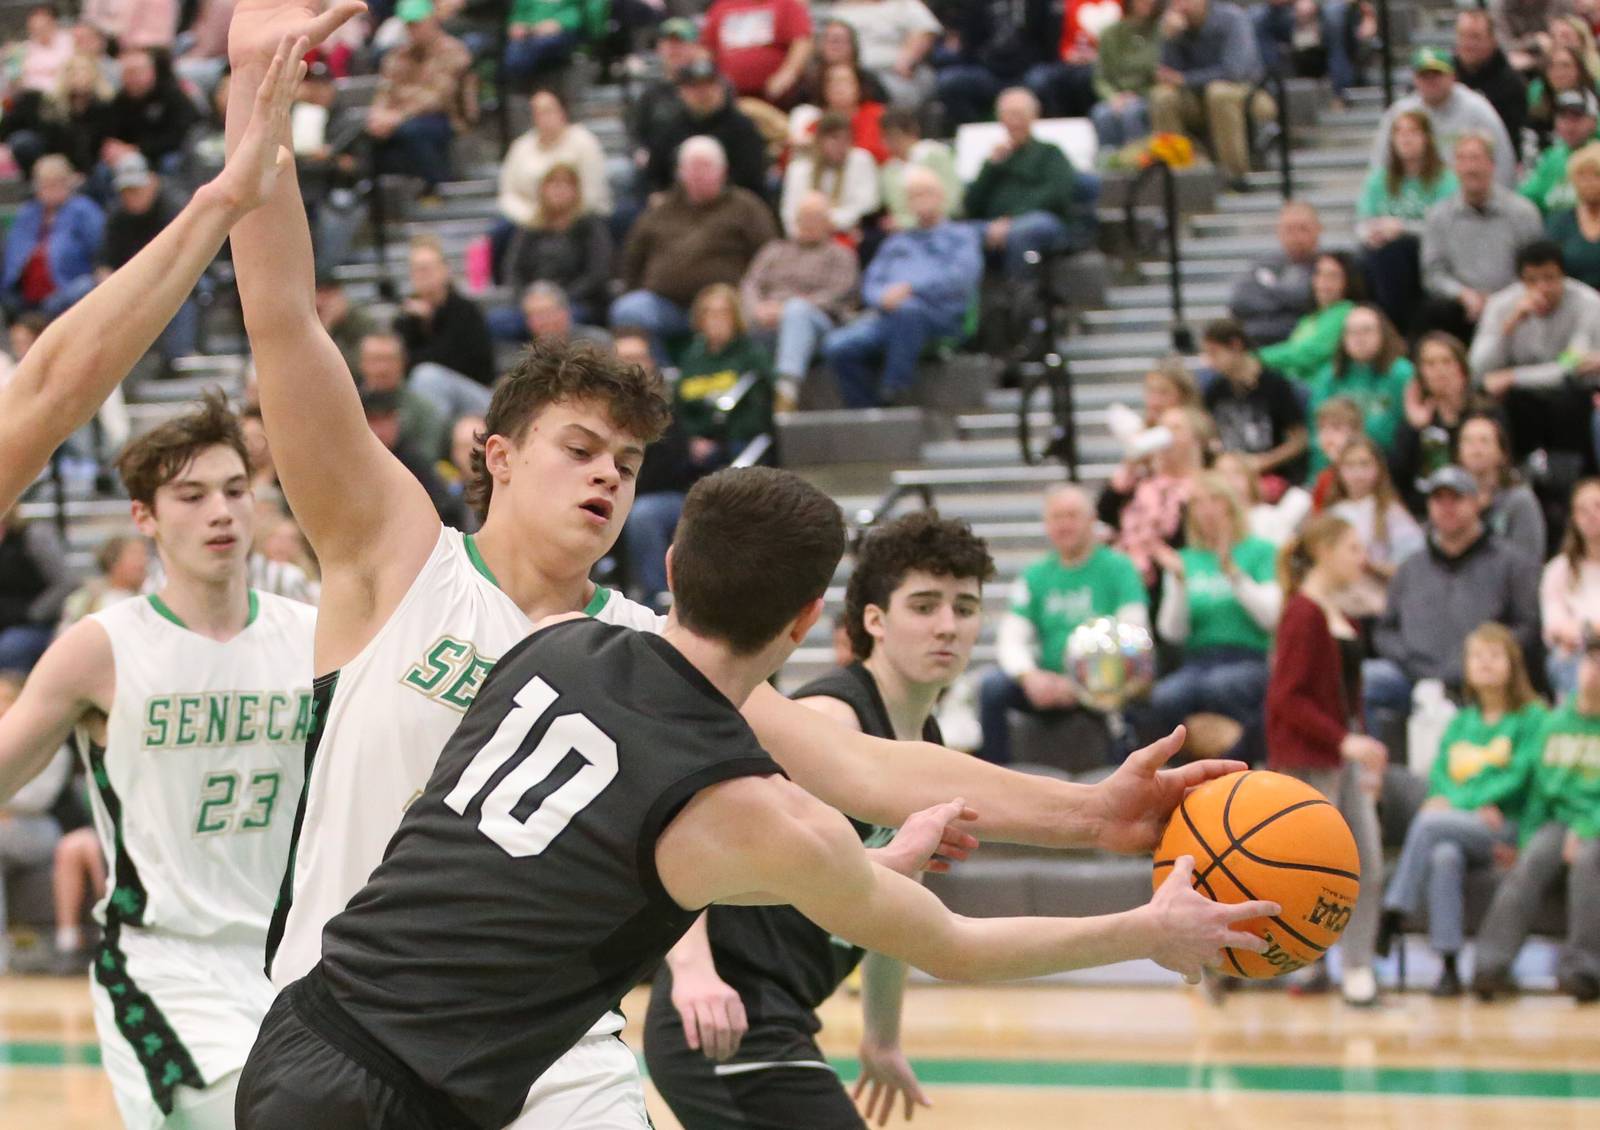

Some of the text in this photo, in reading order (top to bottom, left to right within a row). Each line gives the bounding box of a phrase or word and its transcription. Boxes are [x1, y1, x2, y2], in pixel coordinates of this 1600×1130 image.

[142, 691, 313, 749] SENECA
[442, 673, 620, 859] 10
[193, 770, 283, 837] 23
[1308, 895, 1353, 932] CAA
